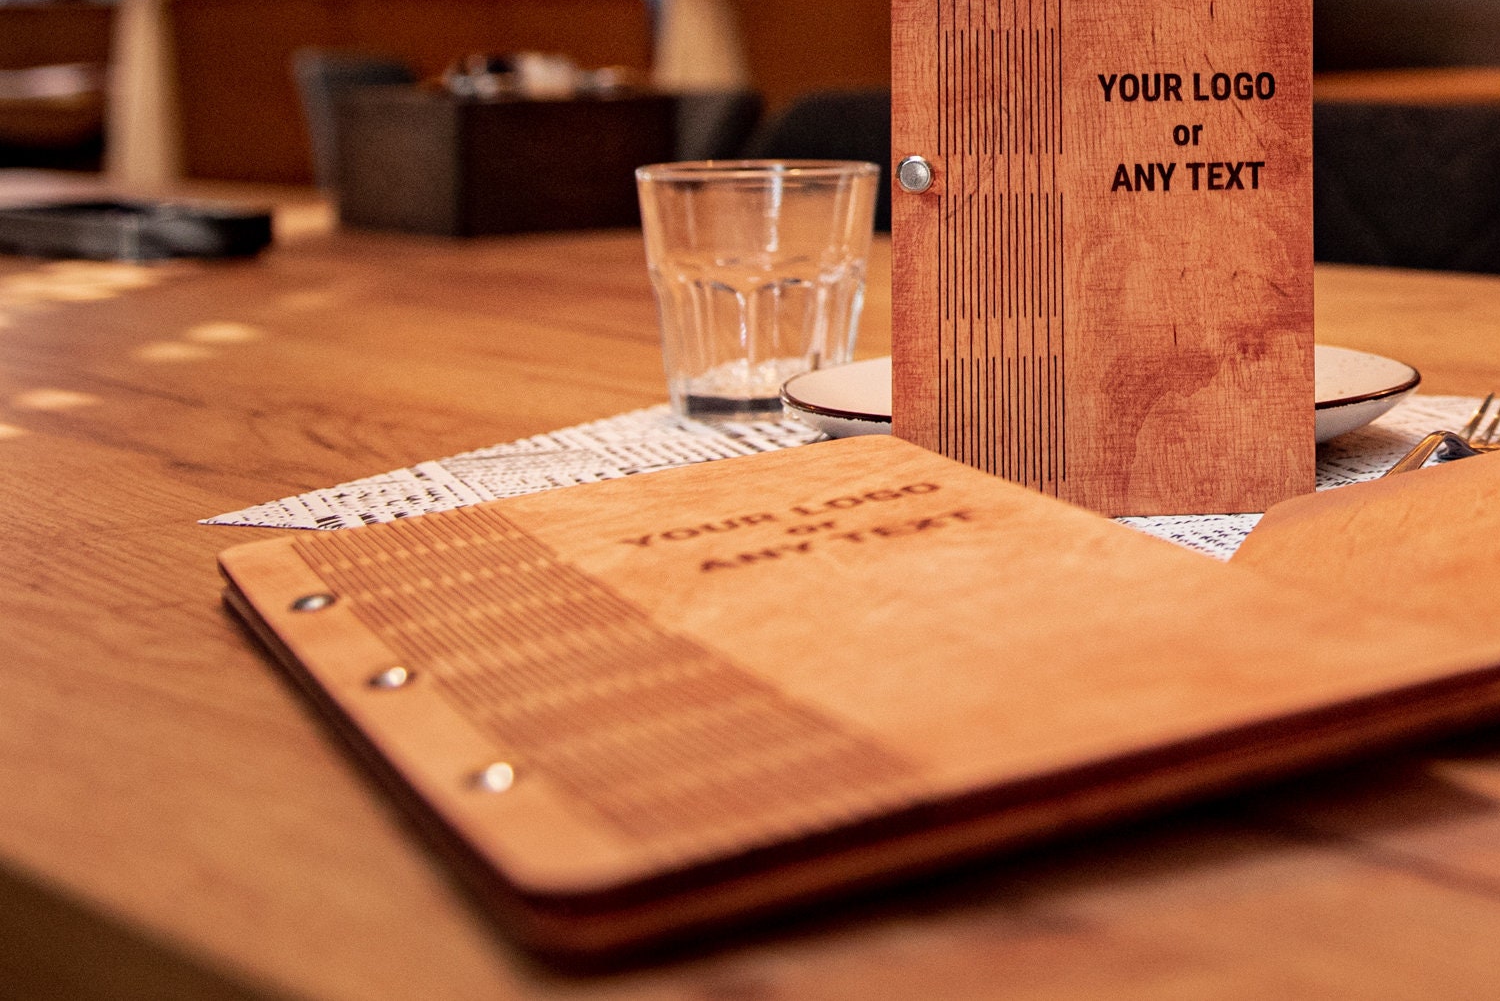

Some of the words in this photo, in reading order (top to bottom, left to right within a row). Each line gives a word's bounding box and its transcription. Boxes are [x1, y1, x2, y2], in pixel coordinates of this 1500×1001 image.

[1098, 73, 1183, 102] YOUR
[1193, 72, 1276, 101] LOGO
[1173, 124, 1203, 146] or
[1111, 163, 1176, 192] ANY
[1186, 161, 1265, 190] TEXT
[618, 511, 778, 548] YOUR
[790, 482, 941, 517] LOGO
[785, 519, 838, 537] or
[700, 541, 812, 573] ANY
[833, 508, 974, 543] TEXT
